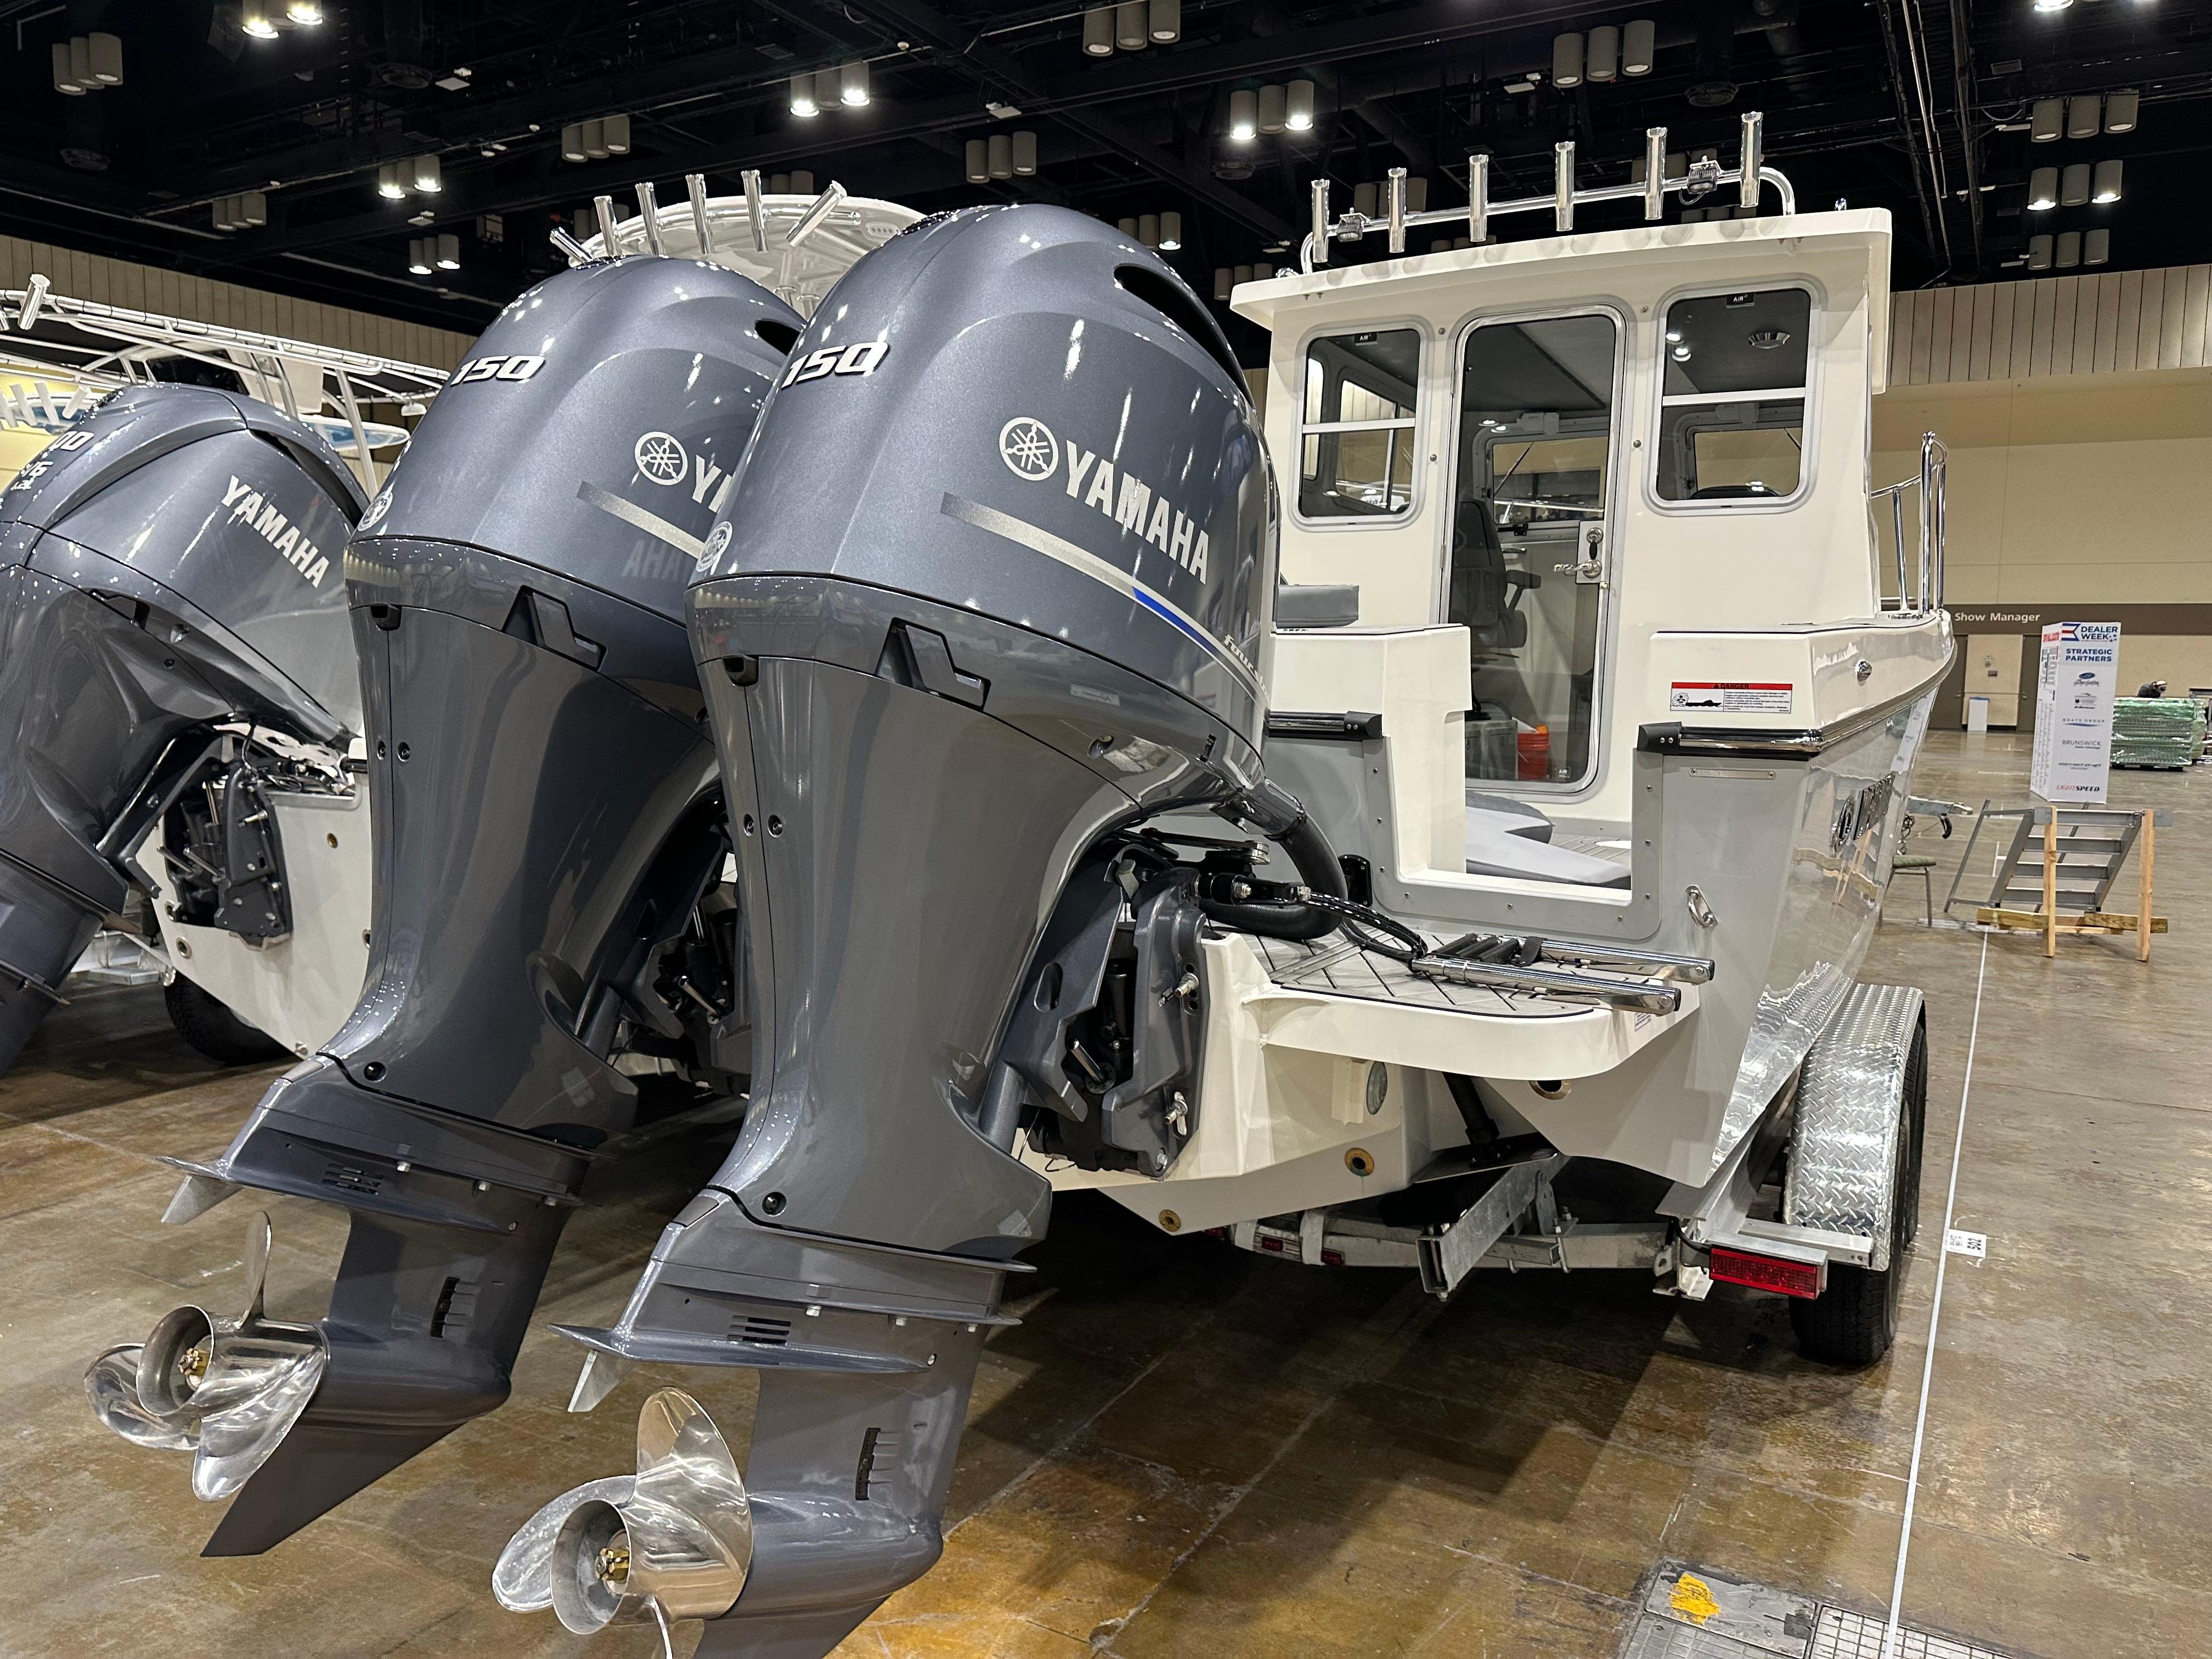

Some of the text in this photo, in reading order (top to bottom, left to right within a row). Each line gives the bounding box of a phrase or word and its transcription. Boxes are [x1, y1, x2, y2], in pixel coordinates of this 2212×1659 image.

[450, 356, 545, 386] 150
[781, 342, 890, 390] 150
[221, 475, 330, 588] YAMAHA
[1066, 439, 1209, 585] YAMAHA
[1955, 612, 2040, 623] Show Manager
